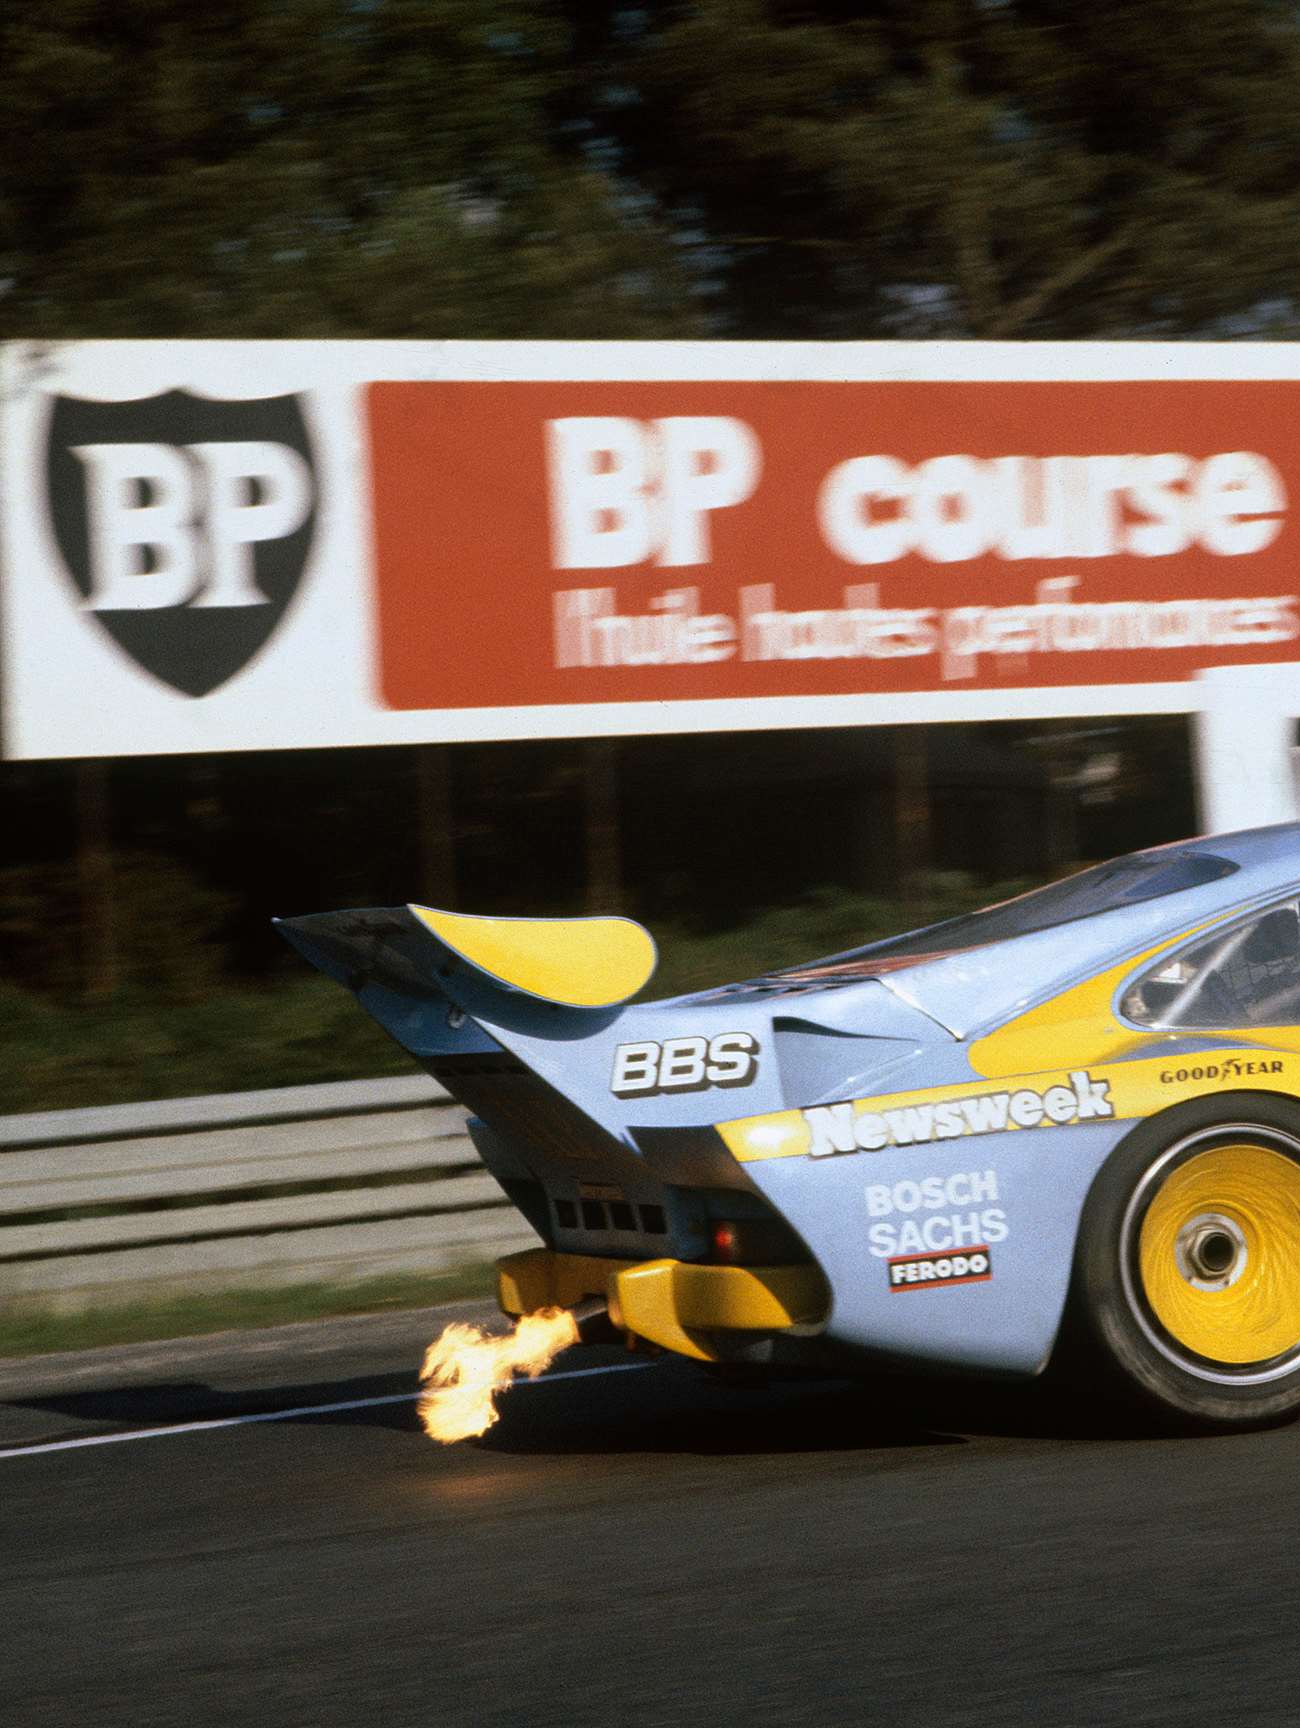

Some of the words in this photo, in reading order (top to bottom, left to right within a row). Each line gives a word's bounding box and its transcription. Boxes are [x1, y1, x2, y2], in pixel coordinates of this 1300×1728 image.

[69, 440, 312, 612] BP
[542, 414, 764, 570] BP
[818, 450, 1289, 565] course
[609, 1031, 761, 1100] BBS
[801, 1070, 1115, 1160] Newsweek
[864, 1169, 998, 1217] BOSCH
[868, 1208, 1009, 1258] SACHS
[890, 1252, 989, 1285] FERODO
